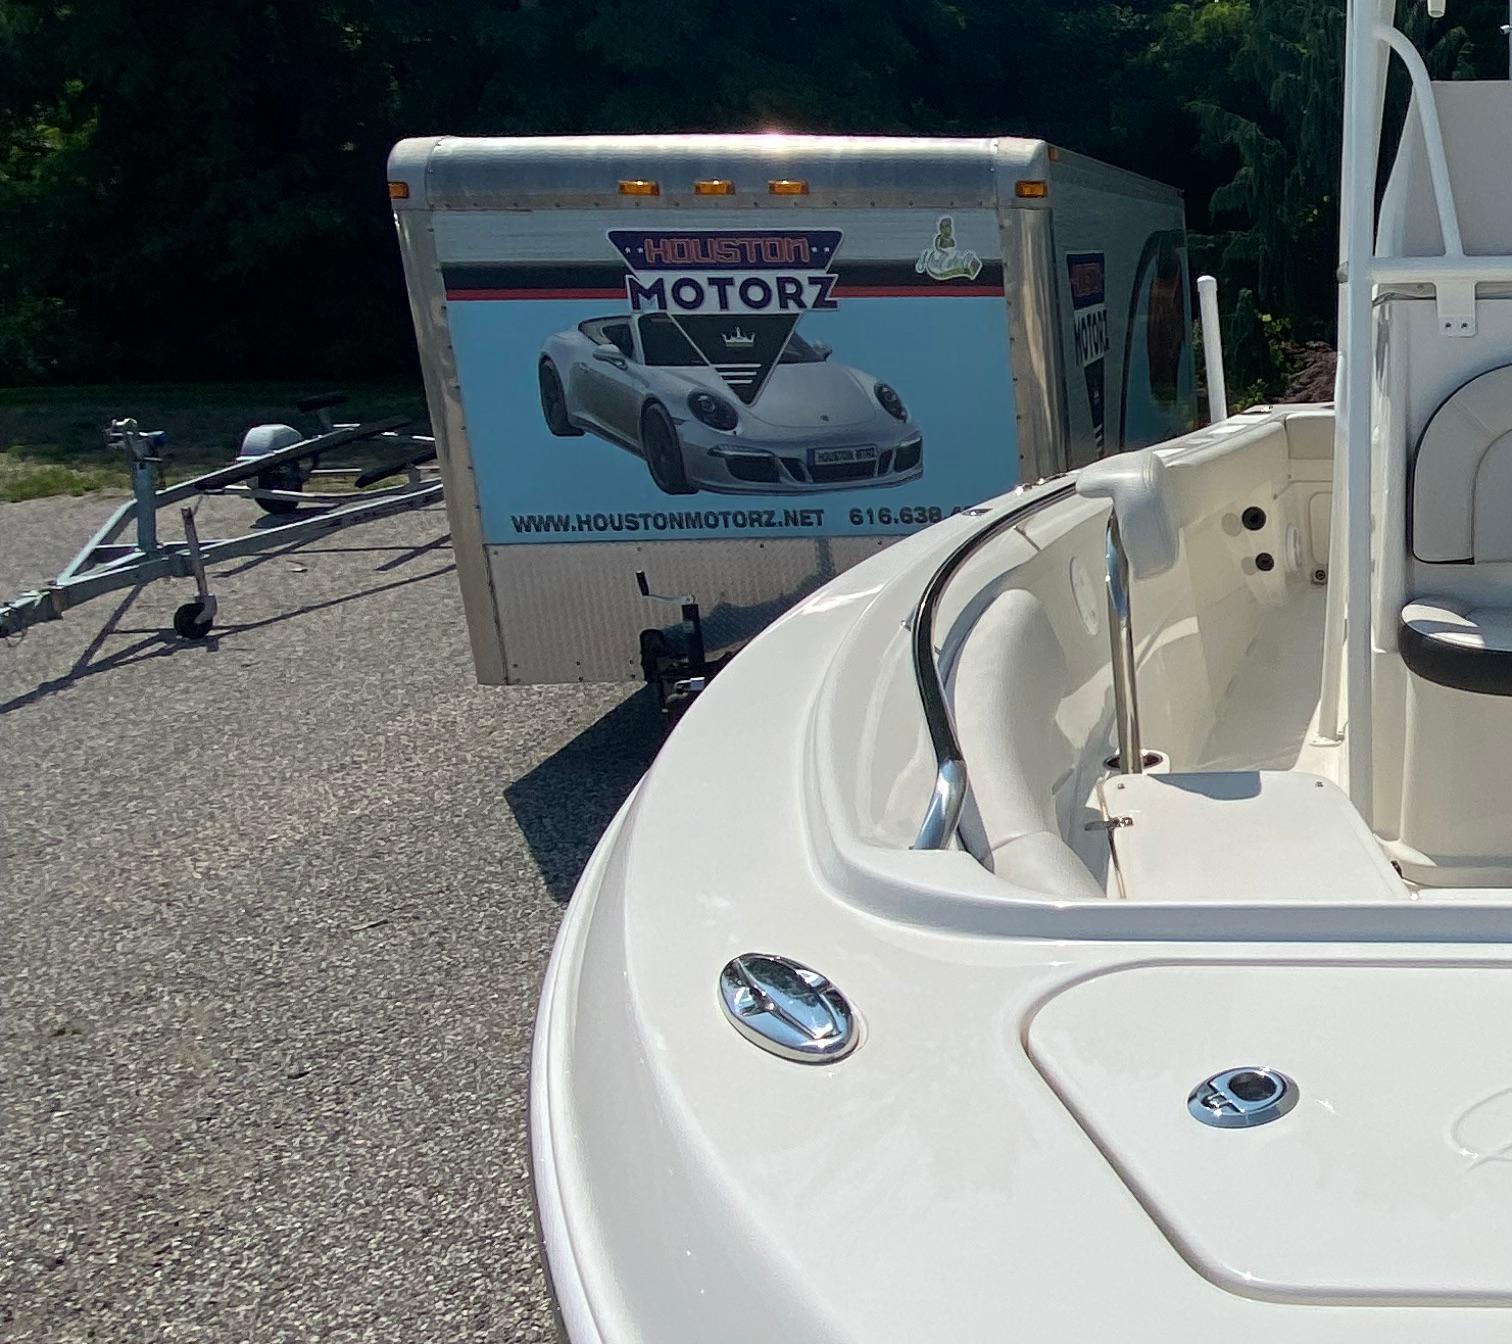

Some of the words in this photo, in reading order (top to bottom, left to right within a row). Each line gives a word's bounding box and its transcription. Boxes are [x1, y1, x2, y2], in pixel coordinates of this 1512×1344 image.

[643, 237, 811, 265] HOUSTON
[628, 275, 839, 311] MOTORZ
[511, 509, 825, 533] WWW.HOUSTONMOTORZ.NET
